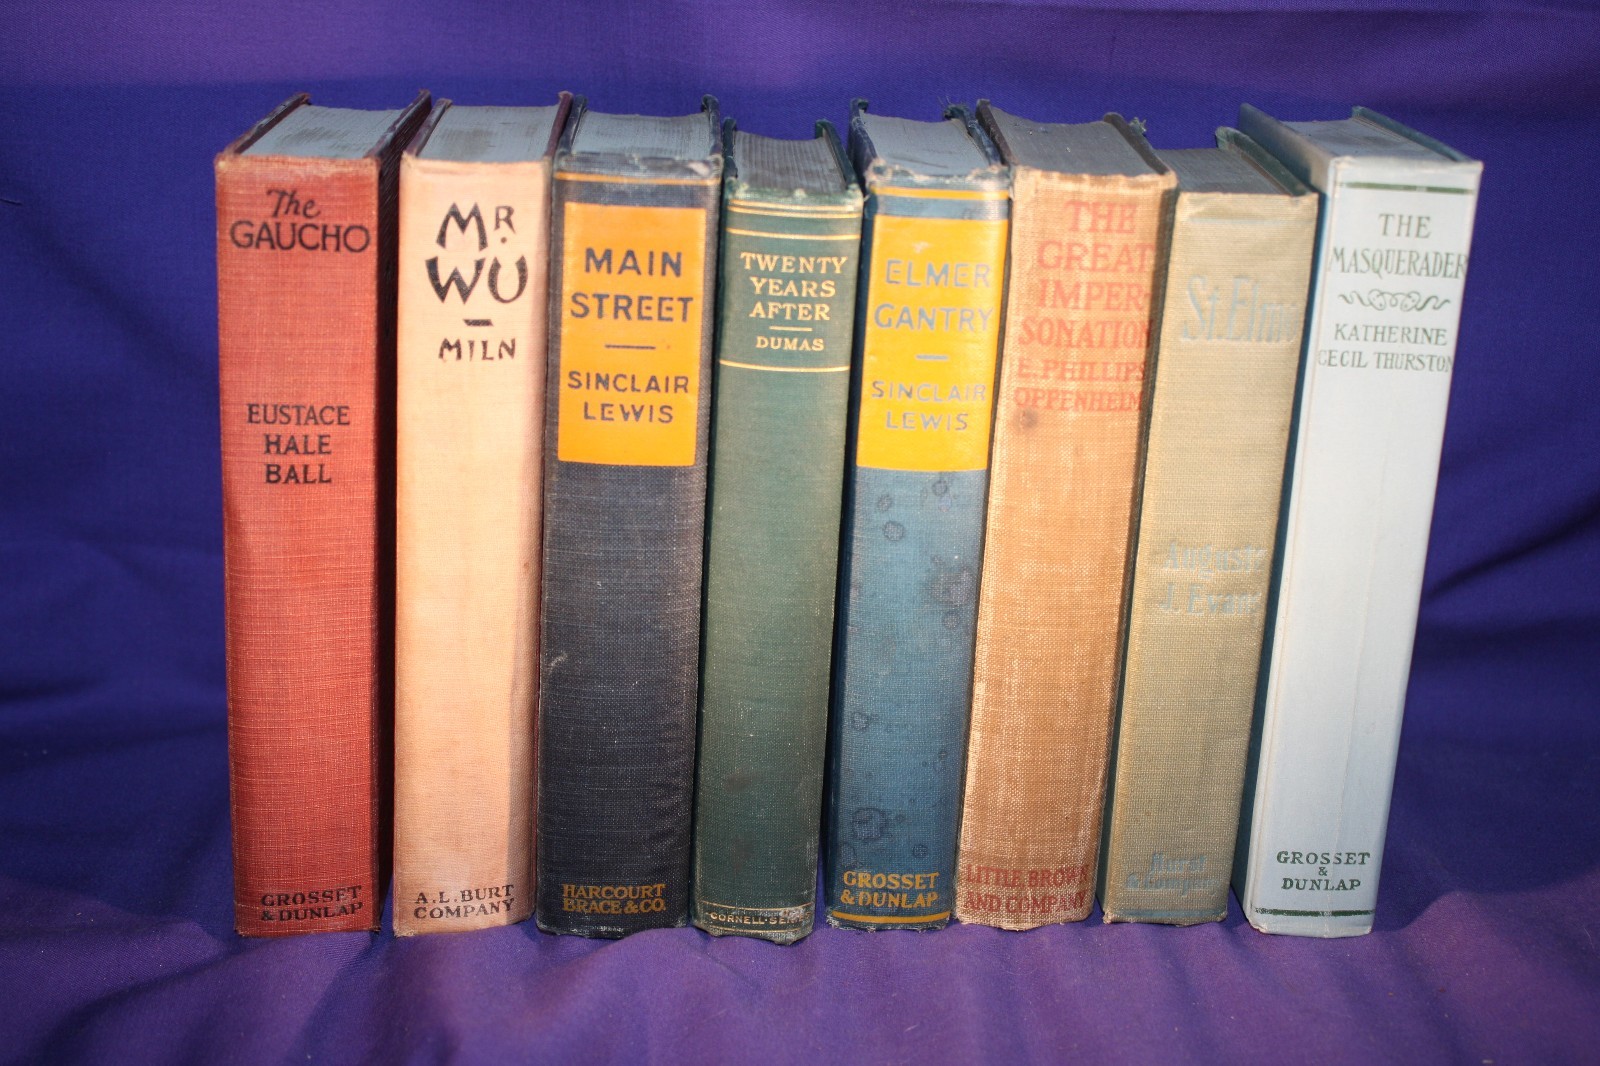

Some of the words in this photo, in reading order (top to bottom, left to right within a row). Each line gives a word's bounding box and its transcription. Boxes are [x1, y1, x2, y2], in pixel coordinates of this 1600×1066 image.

[267, 189, 321, 219] The
[1065, 201, 1137, 234] THE
[1379, 214, 1431, 238] THE
[230, 220, 371, 253] GAUCHO
[584, 247, 682, 277] MAIN
[740, 252, 847, 274] TWENTY
[1037, 240, 1155, 274] GREAT
[1329, 248, 1468, 279] MASQUERADER
[425, 255, 529, 304] WU
[885, 259, 991, 287] ELMER
[750, 277, 836, 297] YEARS
[570, 292, 693, 322] STREET
[749, 303, 830, 321] AFTER
[874, 303, 993, 332] GANTRY
[1018, 316, 1152, 349] SONATION
[1334, 324, 1448, 346] KATHERINE
[438, 338, 517, 362] MILN
[756, 336, 825, 352] DUMAS
[1318, 350, 1368, 369] CECIL
[567, 371, 689, 393] SINCLAIR
[871, 381, 986, 402] SINCLAIR
[1014, 387, 1142, 412] OPPENHEIM
[247, 403, 351, 427] EUSTACE
[583, 402, 673, 423] LEWIS
[885, 412, 968, 431] LEWIS
[264, 434, 332, 455] HALE
[265, 463, 332, 484] BALL
[1277, 851, 1371, 865] GROSSET
[843, 871, 939, 890] GROSSET
[1318, 866, 1328, 876] &
[562, 884, 665, 900] HARCOURT
[1281, 878, 1361, 891] DUNLAP
[260, 885, 362, 908] GROSSET
[562, 900, 620, 914] BRACE
[964, 891, 1001, 912] AND
[1006, 889, 1087, 914] COMPANY
[279, 902, 363, 922] DUNLAP
[414, 898, 513, 919] COMPANY
